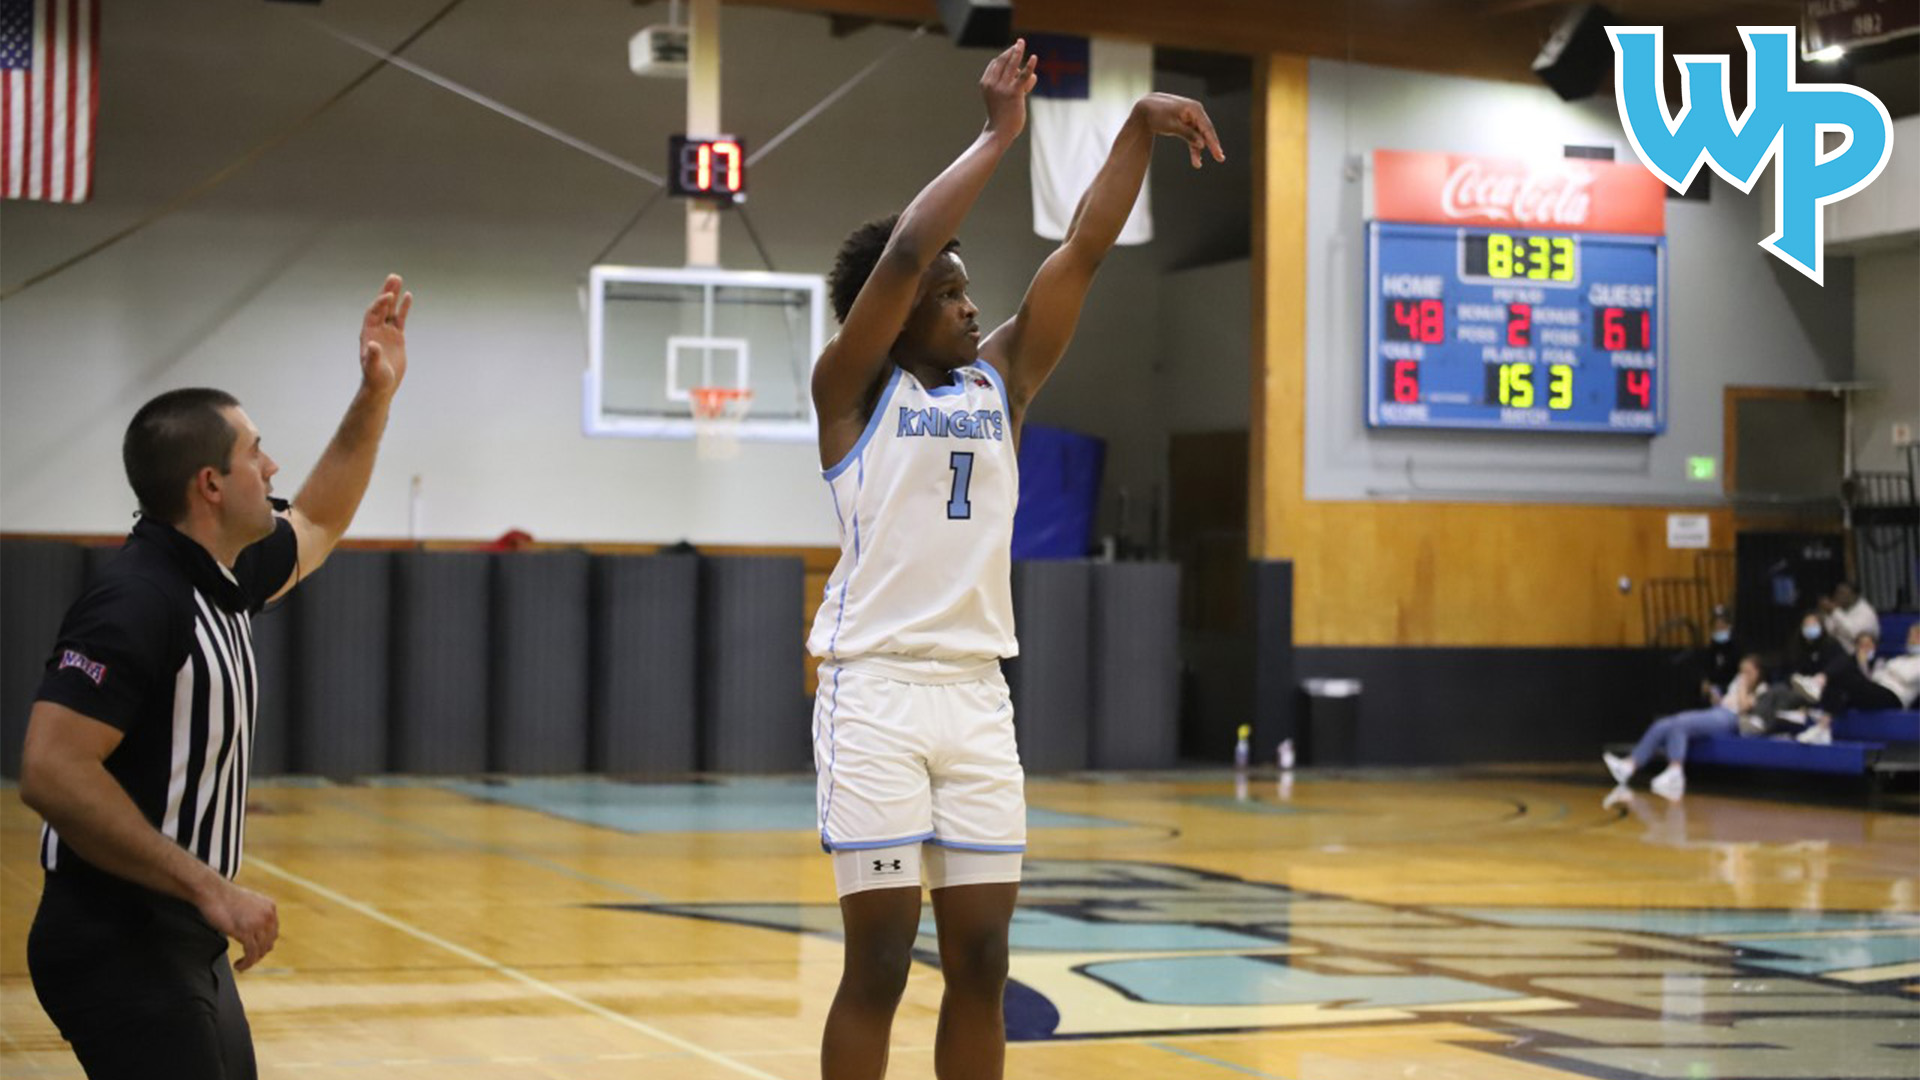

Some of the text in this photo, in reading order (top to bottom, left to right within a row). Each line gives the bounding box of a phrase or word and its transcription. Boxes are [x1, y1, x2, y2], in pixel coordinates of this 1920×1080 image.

[696, 140, 741, 191] 17
[1441, 162, 1597, 225] CocaCola
[1487, 233, 1574, 281] 8:33
[1383, 275, 1443, 297] HOME
[1588, 283, 1654, 307] GUEST
[1394, 299, 1444, 344] 48
[1507, 302, 1532, 347] 2
[1603, 307, 1650, 351] 61
[1394, 359, 1419, 404] 6
[1499, 362, 1534, 408] 15
[1549, 364, 1573, 410] 3
[1626, 368, 1651, 411] 4
[896, 406, 1003, 441] KNIGHTS
[947, 451, 974, 520] 1
